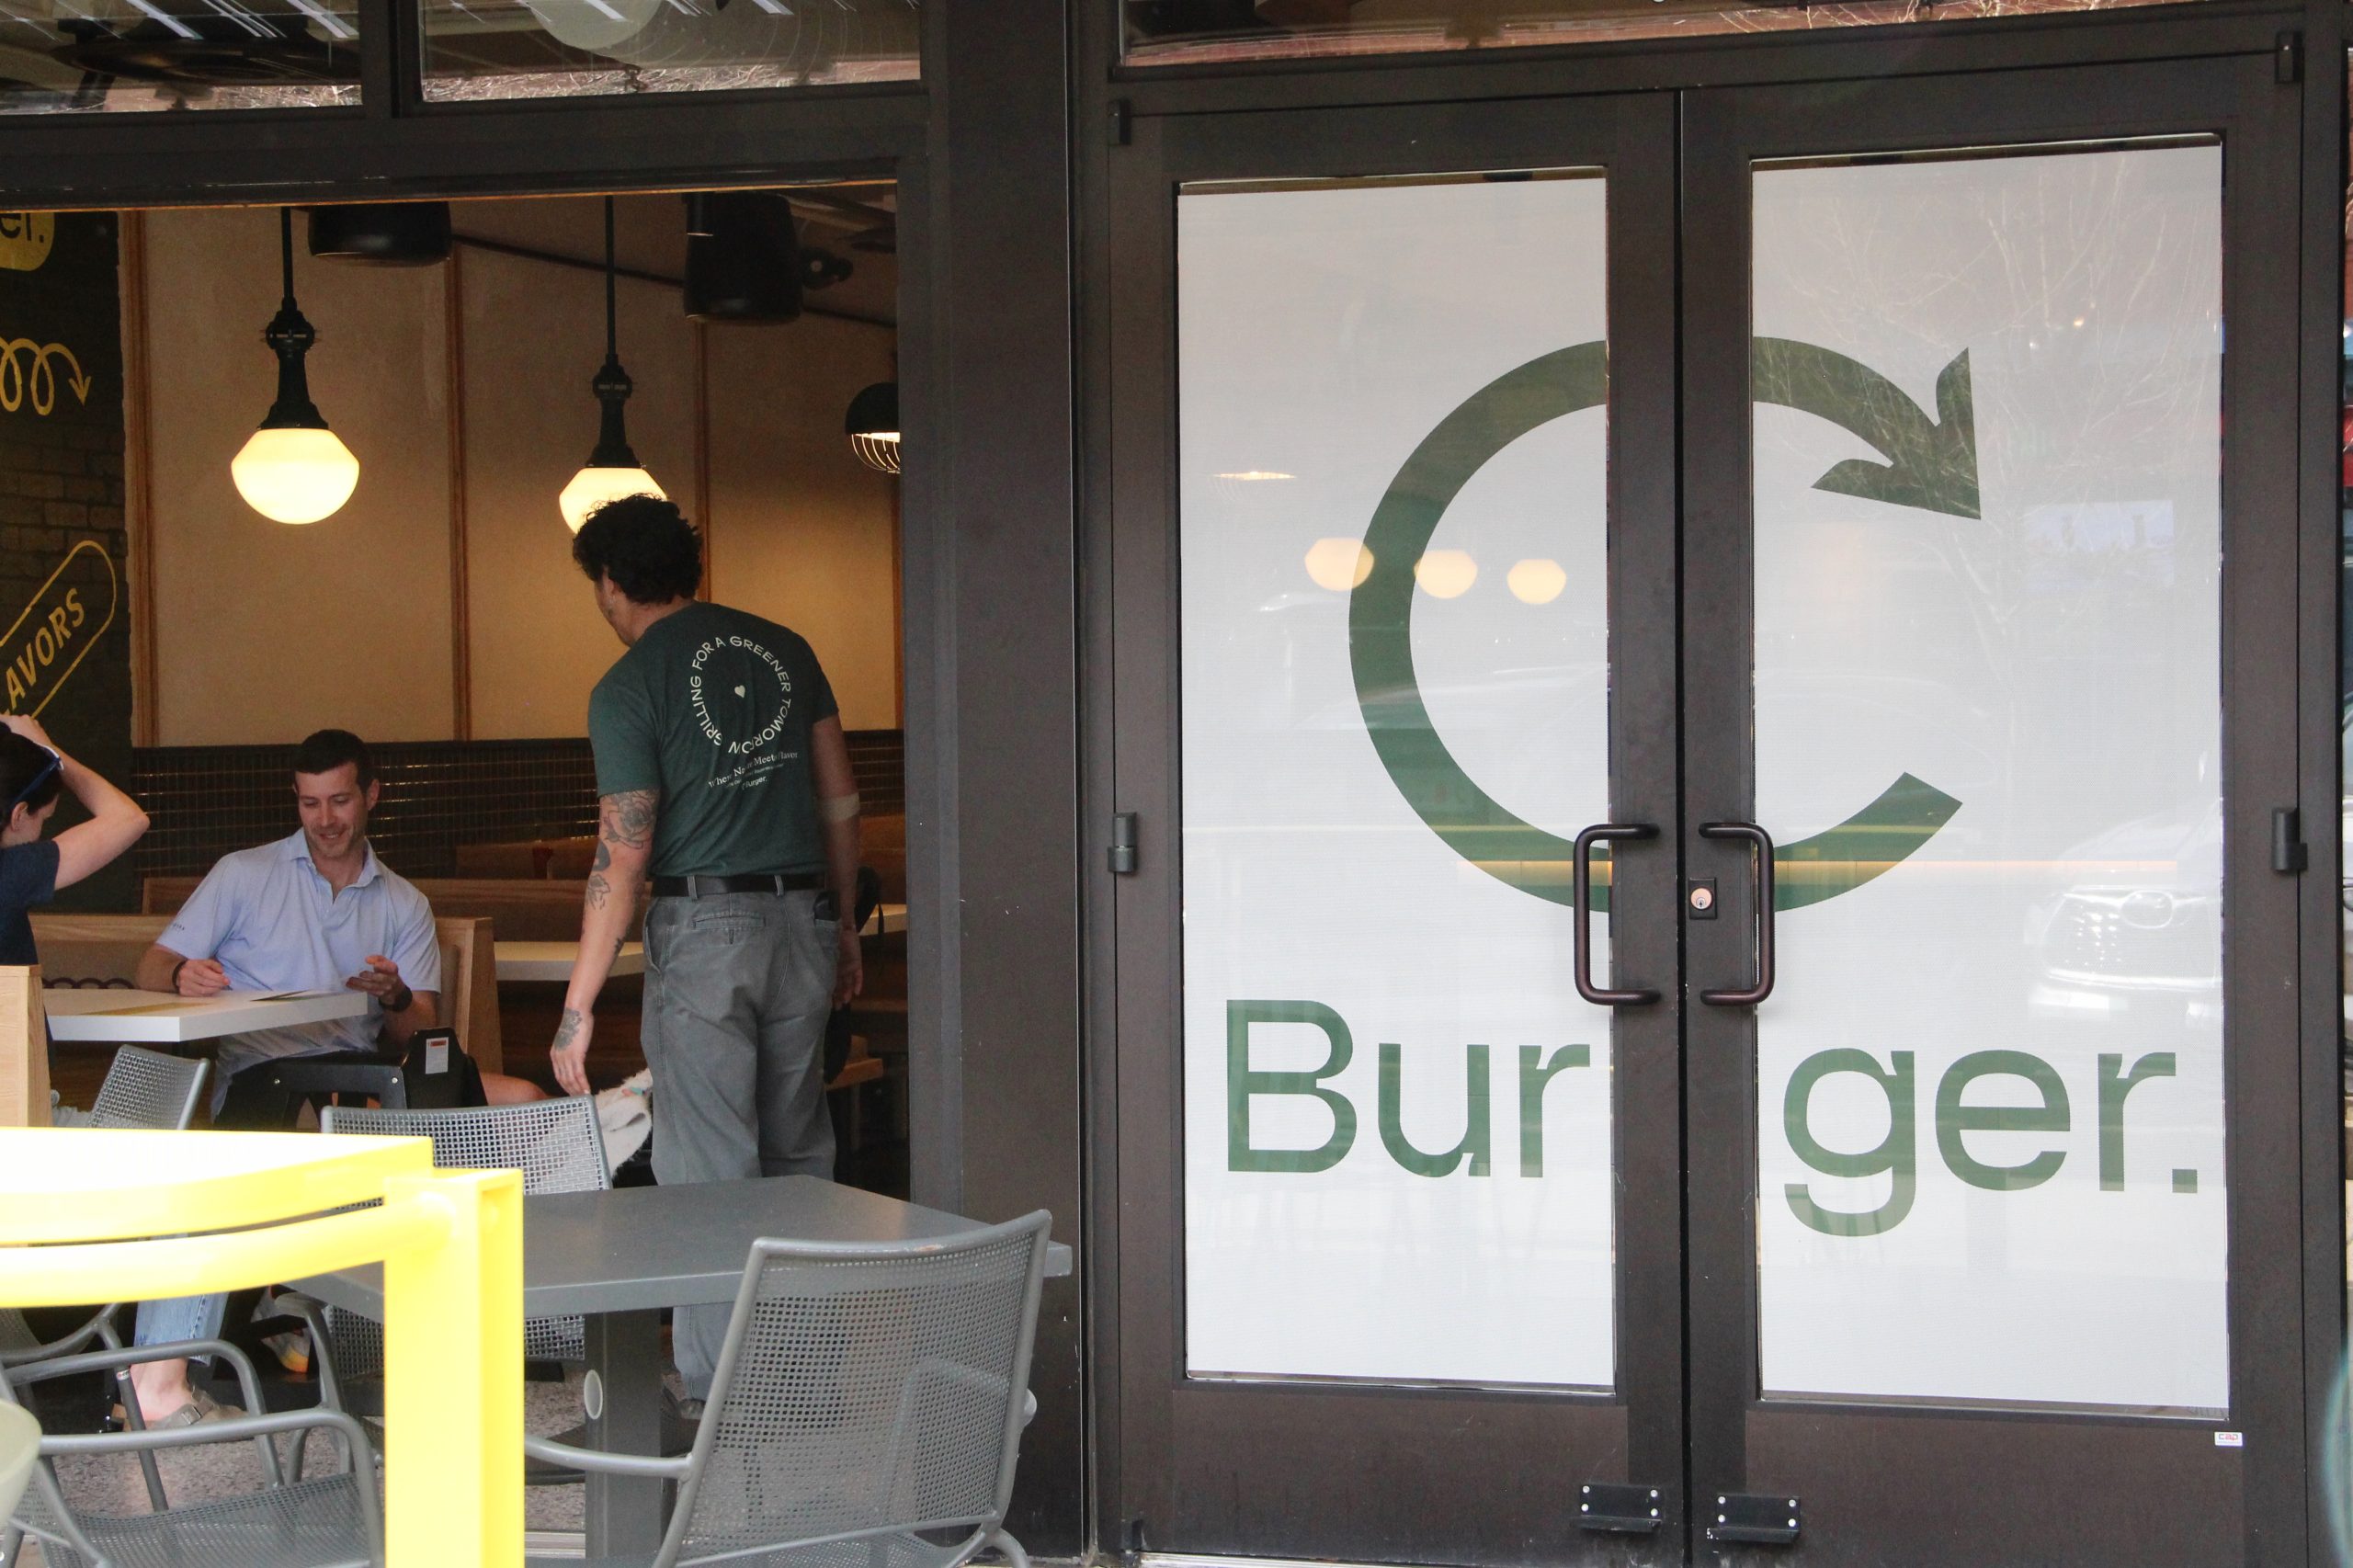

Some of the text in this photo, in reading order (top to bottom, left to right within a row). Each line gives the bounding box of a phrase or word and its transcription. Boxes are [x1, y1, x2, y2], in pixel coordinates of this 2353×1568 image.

[3, 587, 85, 715] AVORS
[691, 642, 715, 671] FOR
[714, 636, 727, 648] A
[729, 635, 791, 692] GREENER
[728, 698, 791, 755] TOMOROW
